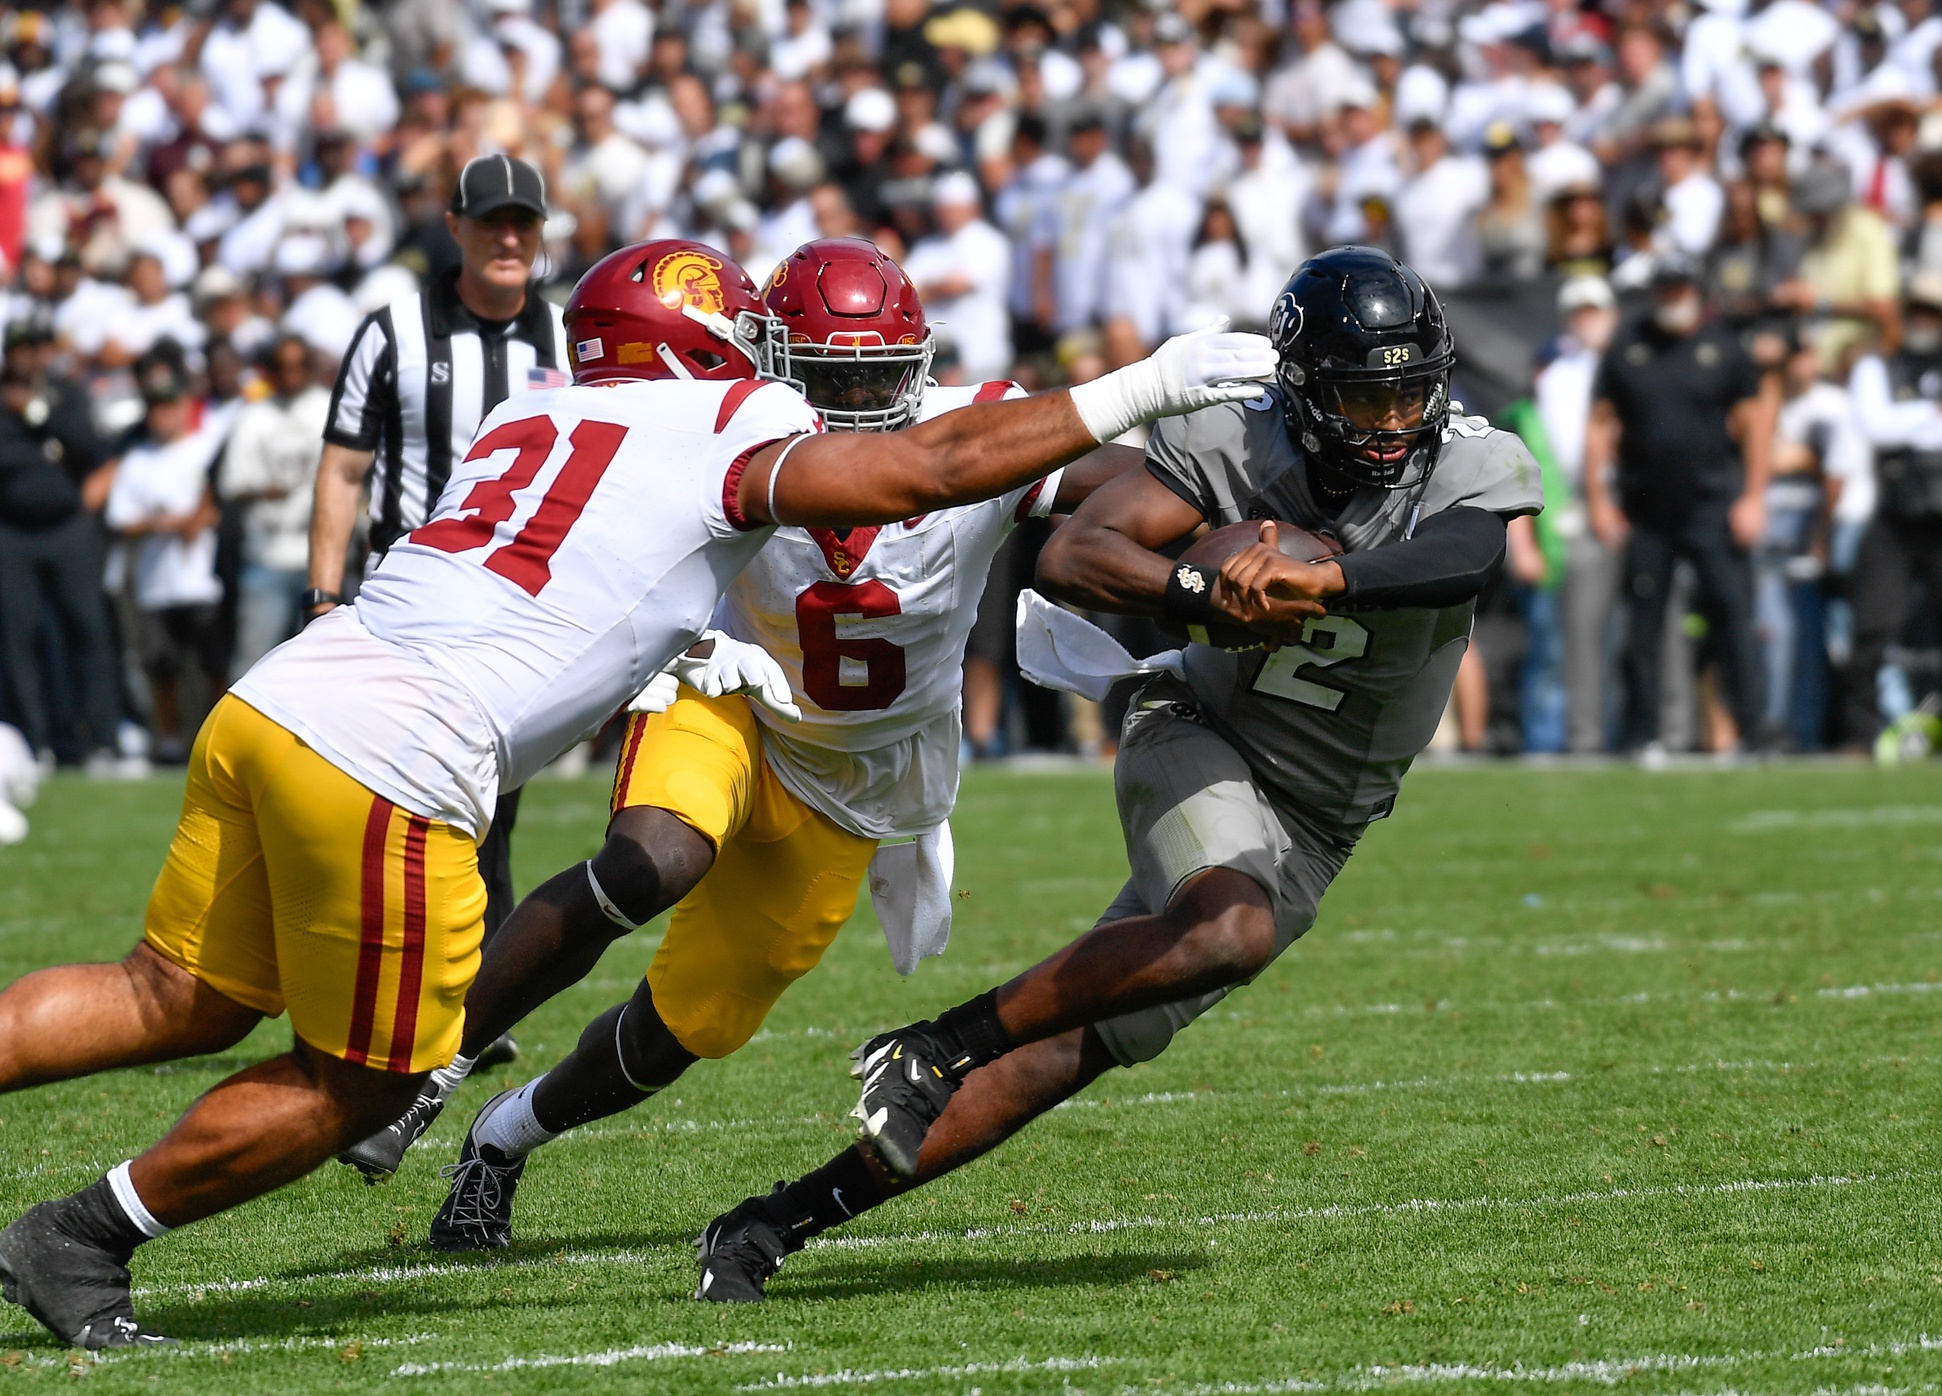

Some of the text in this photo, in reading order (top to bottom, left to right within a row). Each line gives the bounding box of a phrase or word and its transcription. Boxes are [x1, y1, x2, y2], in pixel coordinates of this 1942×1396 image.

[1384, 348, 1409, 364] S2S
[408, 414, 629, 598] 31
[833, 551, 850, 574] SC
[795, 578, 907, 711] 6
[1252, 615, 1369, 711] 2
